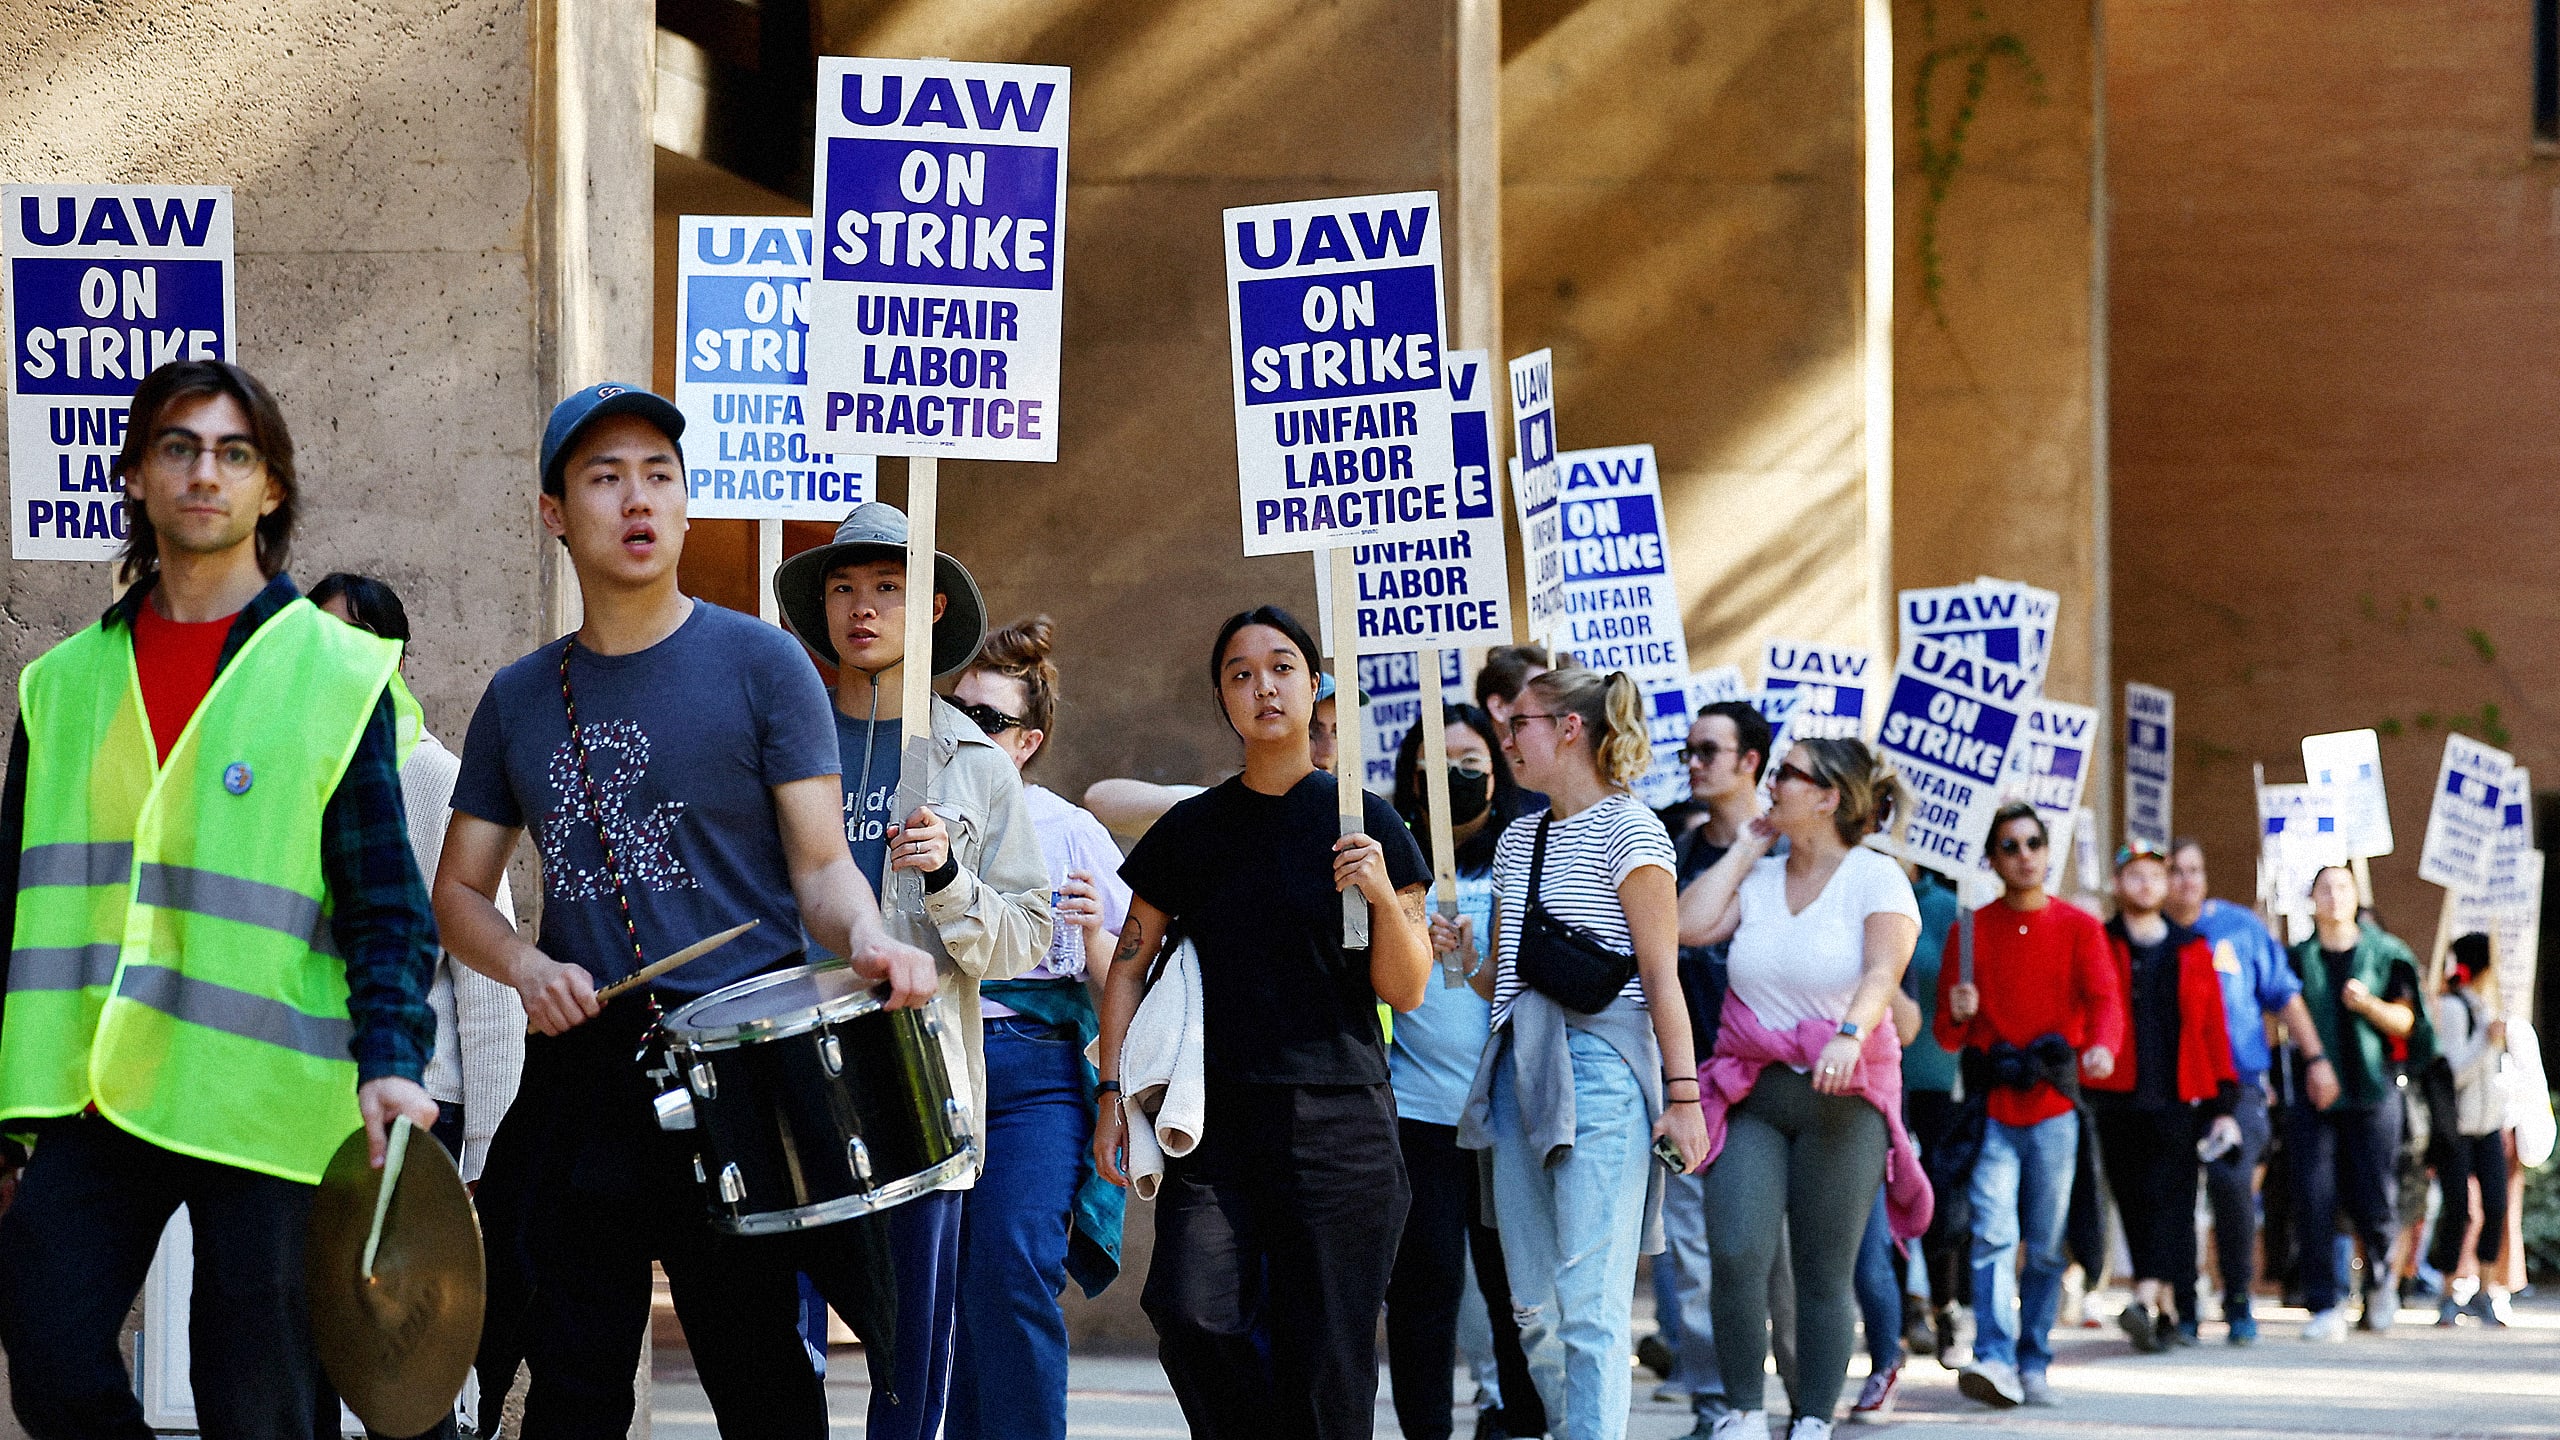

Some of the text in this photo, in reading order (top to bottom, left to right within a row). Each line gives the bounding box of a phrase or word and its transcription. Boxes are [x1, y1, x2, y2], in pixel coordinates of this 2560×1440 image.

[841, 73, 1056, 133] UAW
[899, 149, 986, 206] ON
[20, 196, 217, 248] UAW
[832, 209, 1048, 273] STRIKE
[1237, 206, 1431, 270] UAW
[698, 227, 813, 267] UA
[79, 266, 158, 321] ON
[1302, 280, 1375, 333] ON
[856, 295, 1019, 342] UNFAIR
[23, 326, 218, 381] STRIKE
[692, 327, 803, 374] STRI
[863, 344, 1008, 390] LABOR
[1250, 333, 1436, 393] STRIKE
[1515, 362, 1549, 409] UAW
[49, 407, 130, 447] UNF
[713, 394, 805, 426] UNFA
[825, 392, 1043, 440] PRACTICE
[1274, 400, 1418, 448] UNFAIR
[690, 468, 862, 503] PRACTICE
[1284, 444, 1414, 490] LABOR
[1566, 457, 1645, 490] AW
[28, 499, 132, 540] PRAC
[1256, 483, 1448, 537] PRACTICE
[1567, 499, 1621, 539] ON
[1561, 532, 1664, 577] TRIKE
[1358, 566, 1468, 601] LABOR
[1565, 586, 1652, 614] UNFAIR
[1357, 600, 1499, 638] RACTICE
[1572, 615, 1652, 643] LABOR
[1910, 593, 2017, 625] UAW
[1358, 649, 1459, 691] STRIE
[1573, 641, 1676, 669] RACTICE
[1771, 647, 1867, 677] UAW
[1912, 643, 2026, 700] UAW
[1373, 699, 1422, 727] UNF
[1928, 691, 1982, 734] ON
[2030, 711, 2087, 738] AW
[1882, 711, 2004, 780] STRIKE
